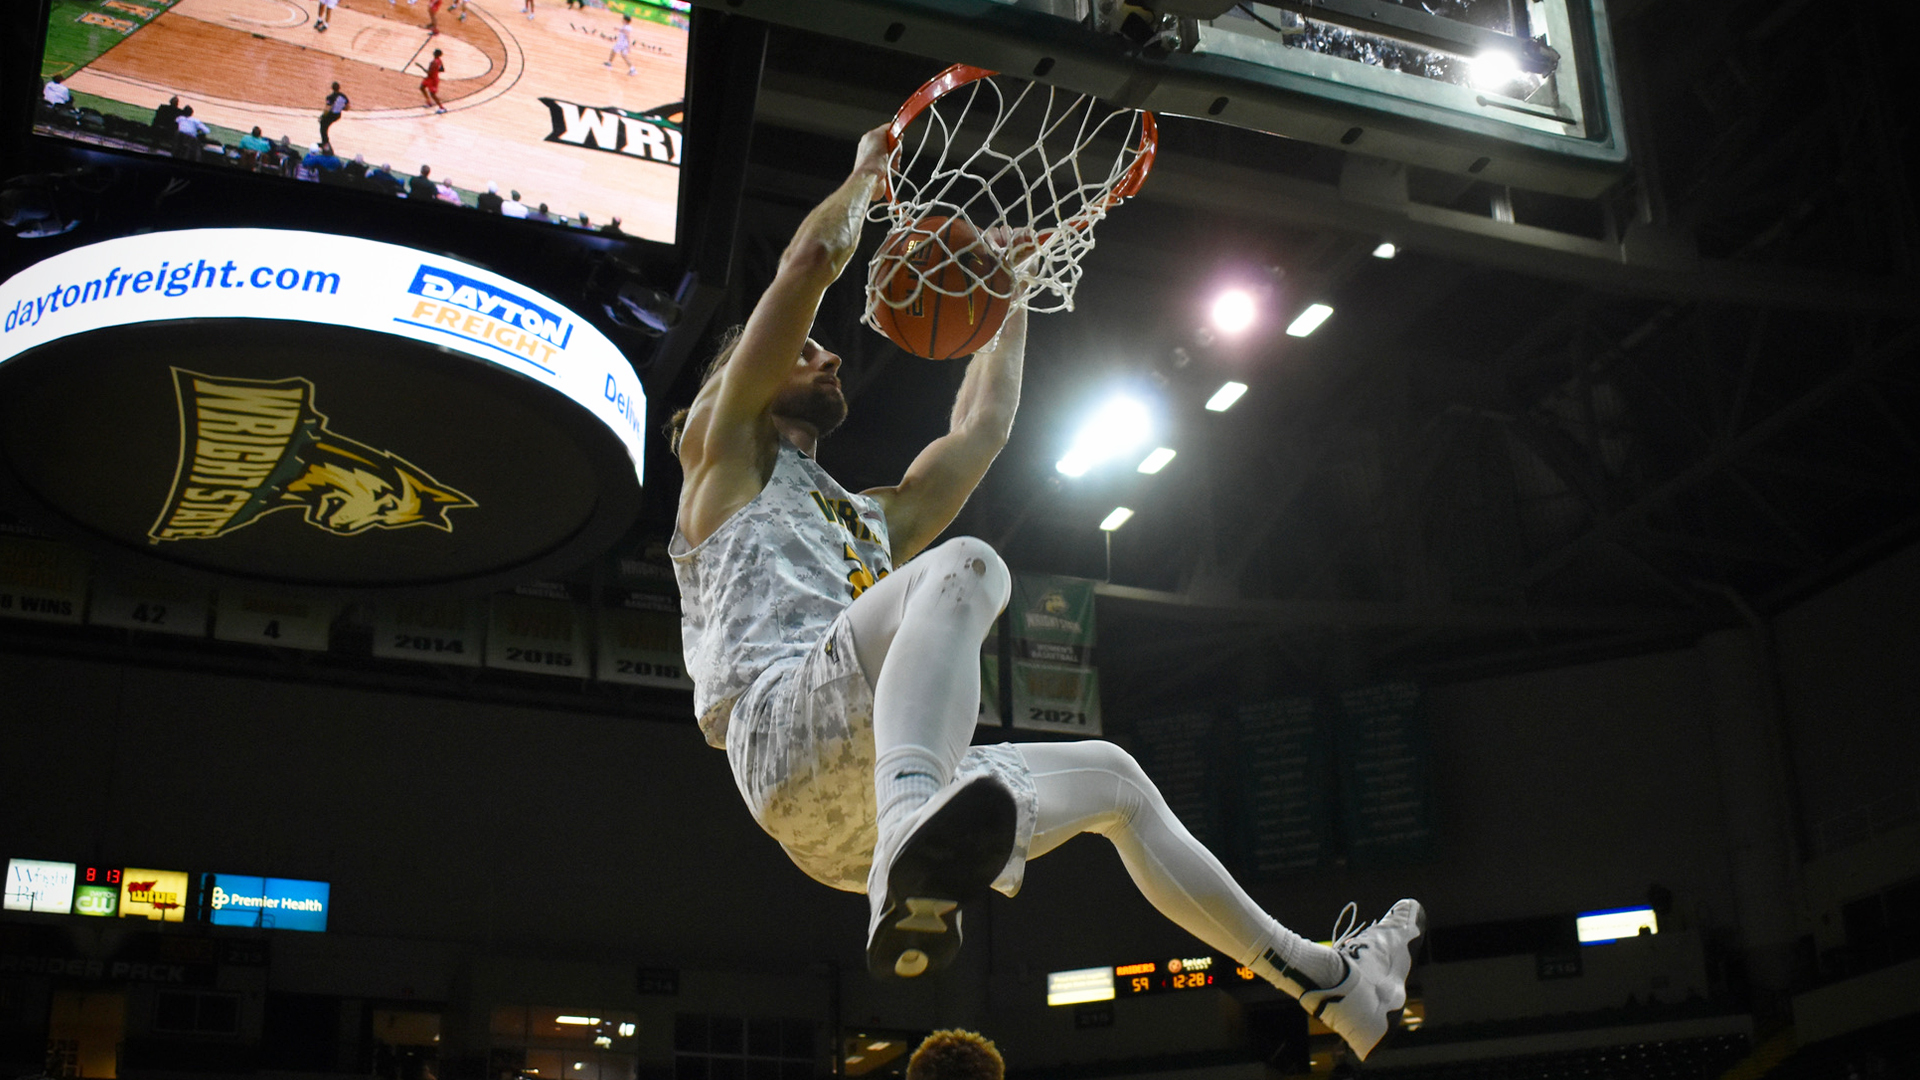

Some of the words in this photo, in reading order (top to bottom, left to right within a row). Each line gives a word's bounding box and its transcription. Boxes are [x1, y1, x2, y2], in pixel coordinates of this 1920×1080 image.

[4, 259, 341, 333] daytonfreight.com
[421, 273, 567, 347] DAYTON
[411, 301, 557, 363] FREIGHT
[193, 379, 303, 488] WRIGHT
[160, 487, 253, 537] STATE
[21, 596, 72, 615] WINS
[131, 603, 166, 625] 42
[263, 620, 281, 640] 4
[394, 634, 463, 654] 2014
[506, 647, 573, 667] 2015
[616, 659, 681, 679] 2016
[1029, 707, 1086, 725] 2021
[86, 867, 96, 882] 8
[106, 869, 120, 884] 13
[75, 895, 116, 914] CW
[231, 893, 280, 909] Premier
[280, 897, 323, 912] Health
[111, 961, 185, 983] PACK
[1116, 963, 1156, 976] RAIDERS
[1182, 956, 1212, 968] Select
[1132, 977, 1150, 992] 59
[1173, 972, 1206, 989] 12:28
